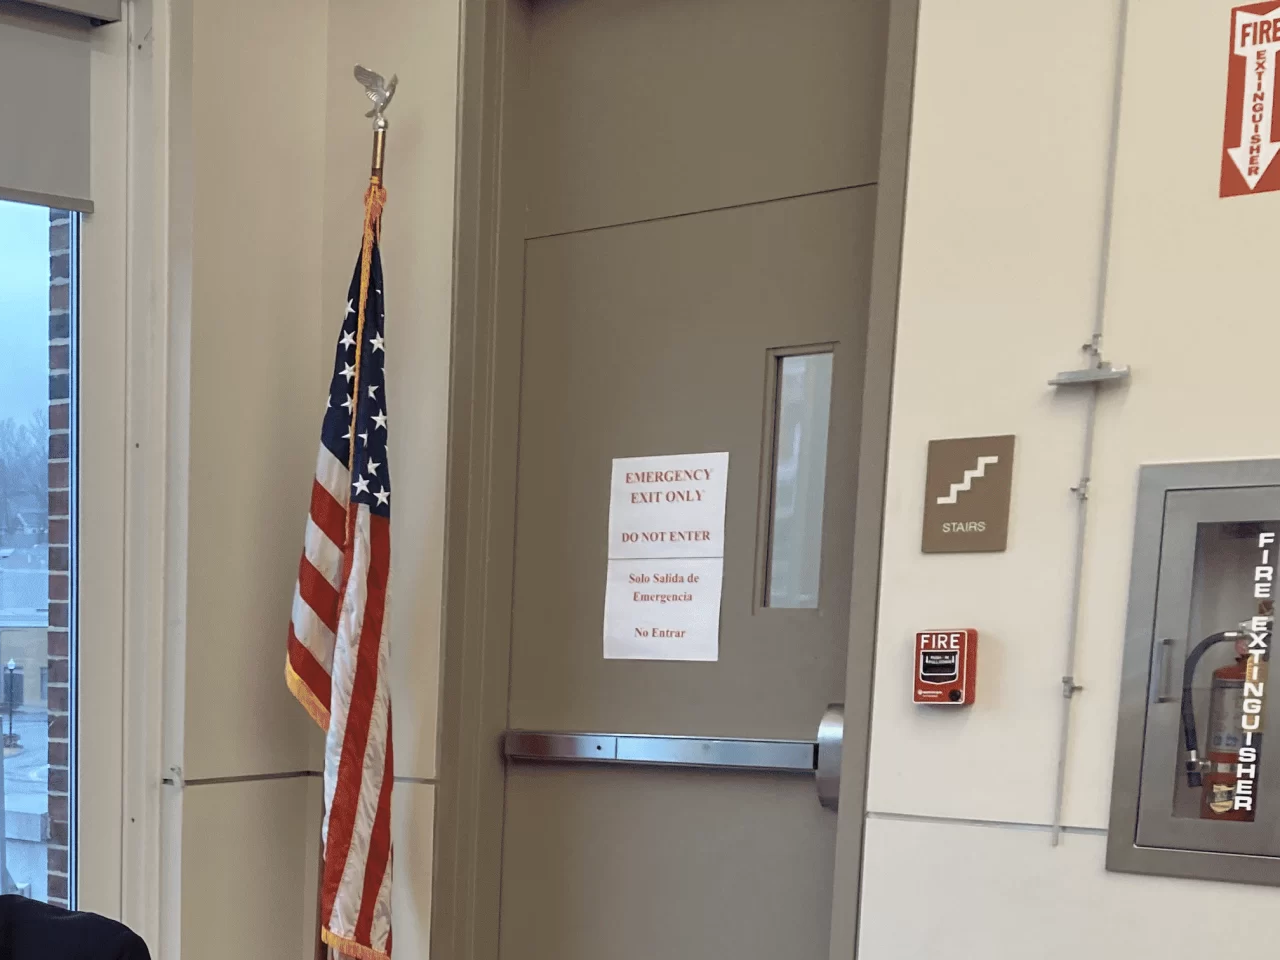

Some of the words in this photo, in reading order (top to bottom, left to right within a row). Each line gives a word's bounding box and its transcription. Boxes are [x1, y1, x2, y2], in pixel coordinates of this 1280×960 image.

[1240, 17, 1280, 47] FIRE
[1247, 49, 1267, 176] EXTINGUISHER
[625, 468, 713, 484] EMERGENCY
[630, 491, 663, 504] EXIT
[665, 489, 705, 503] ONLY
[942, 521, 987, 533] STAIRS
[621, 531, 639, 543] DO
[641, 531, 666, 543] NOT
[669, 530, 711, 542] ENTER
[1253, 532, 1275, 598] FIRE
[628, 573, 650, 584] Solo
[652, 572, 684, 584] Salida
[686, 572, 700, 584] de
[633, 591, 693, 604] Emergencia
[634, 627, 649, 638] No
[651, 627, 686, 639] Entrar
[920, 633, 961, 650] FIRE
[1234, 616, 1268, 811] EXTINGUISHER
